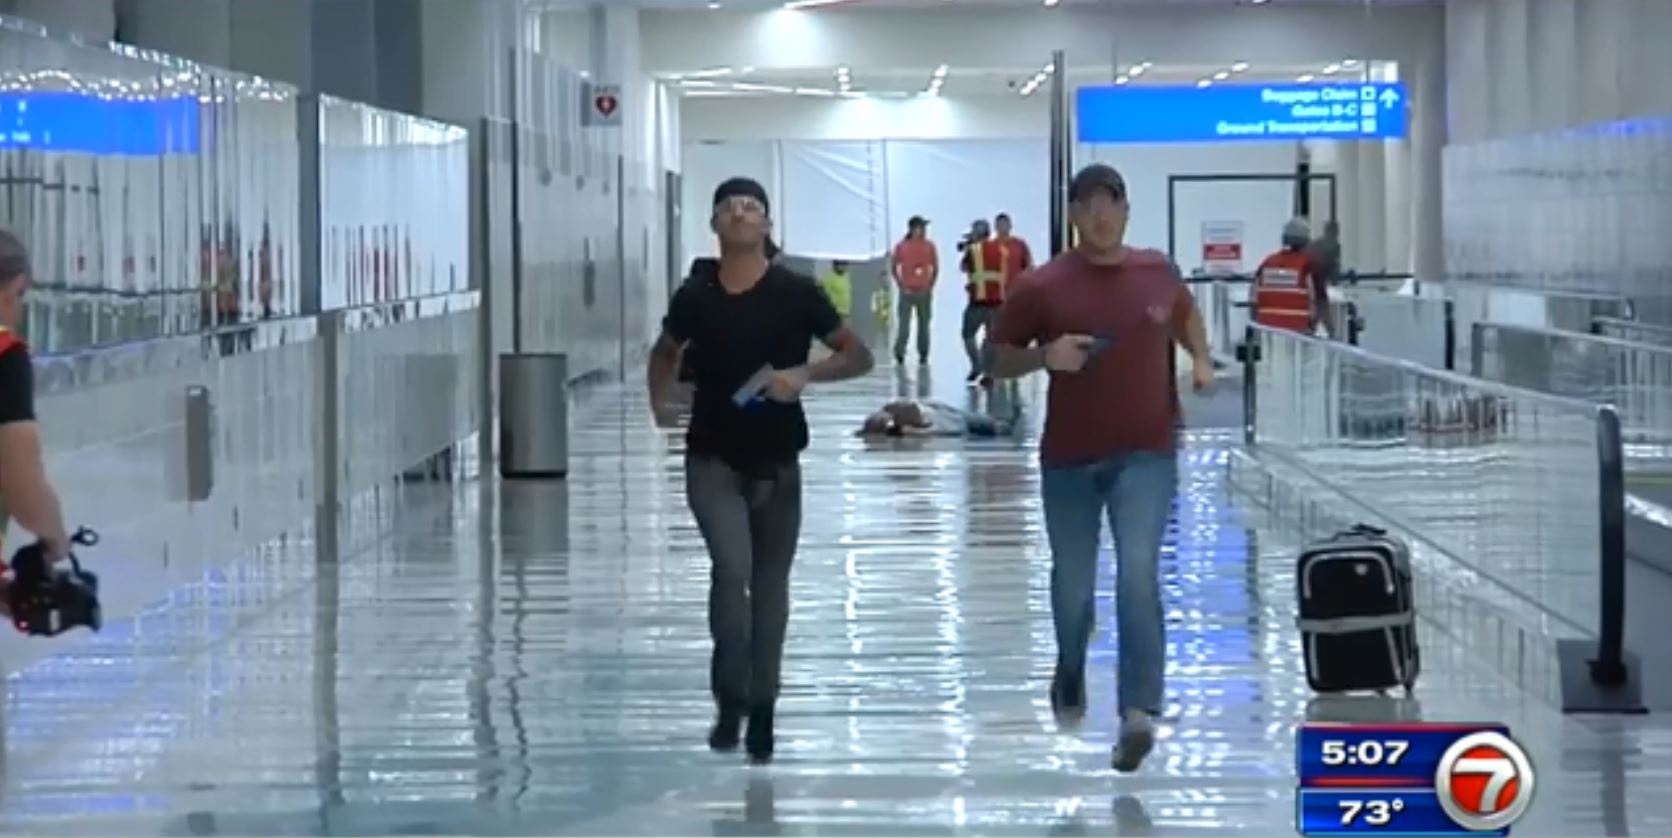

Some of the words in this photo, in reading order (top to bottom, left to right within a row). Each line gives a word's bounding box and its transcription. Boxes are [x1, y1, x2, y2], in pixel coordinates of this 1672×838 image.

[1262, 88, 1319, 103] Baggage
[1216, 121, 1264, 135] Ground
[1267, 120, 1358, 135] Transportation
